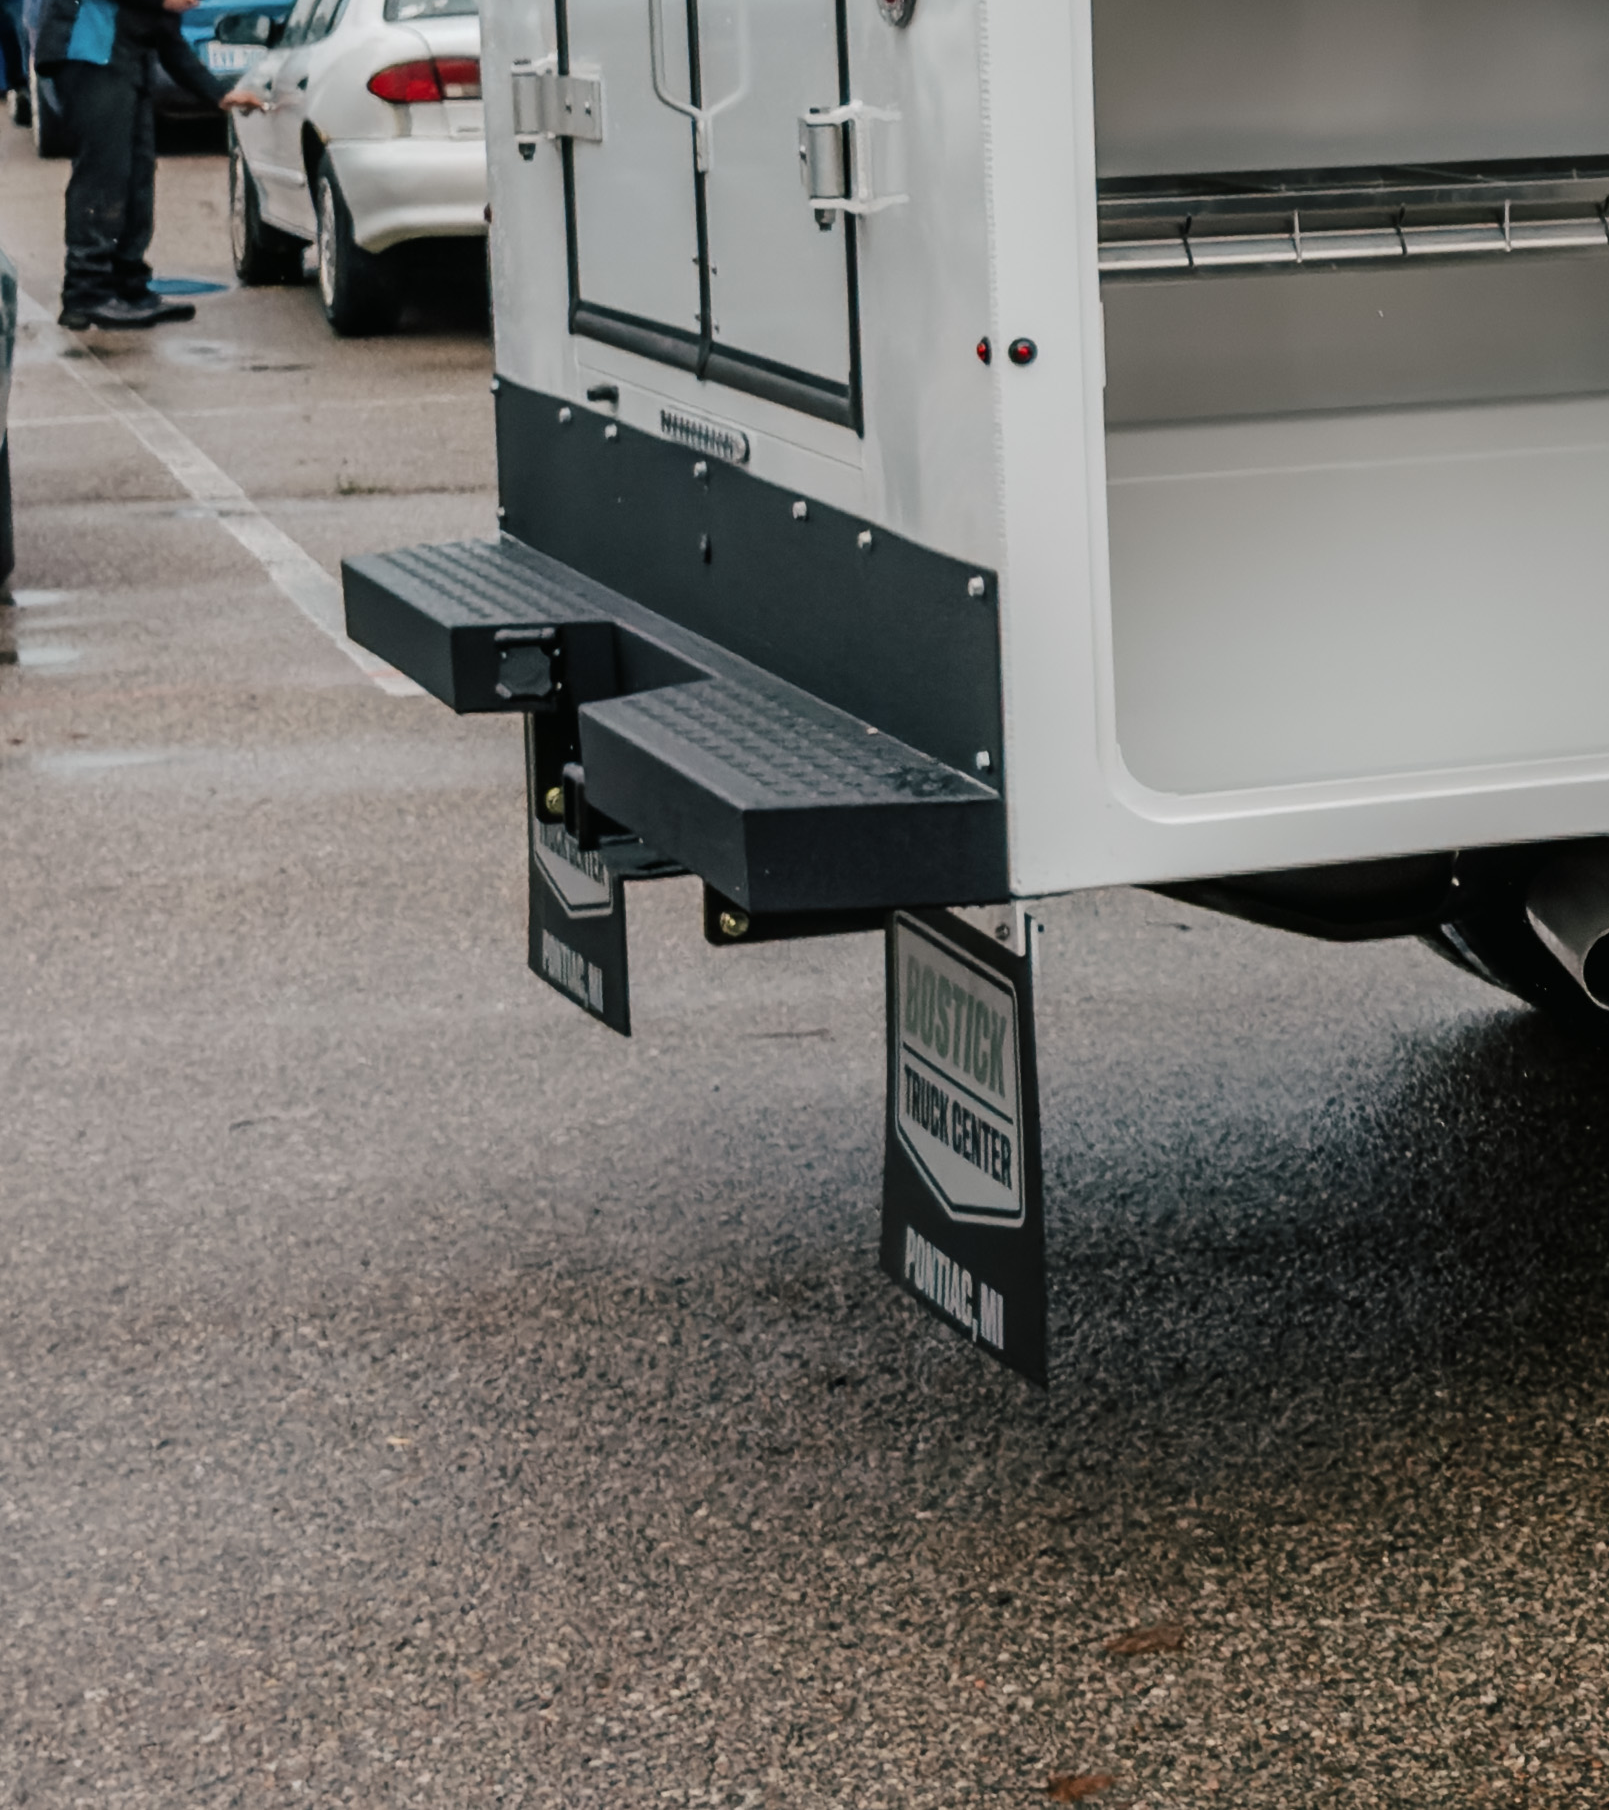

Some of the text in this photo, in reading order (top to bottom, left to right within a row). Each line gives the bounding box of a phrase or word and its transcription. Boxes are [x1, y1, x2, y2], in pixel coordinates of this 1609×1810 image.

[904, 953, 1008, 1100] BOSTICK
[903, 1062, 1013, 1191] TRUCK CENTER
[980, 1281, 1004, 1350] MI
